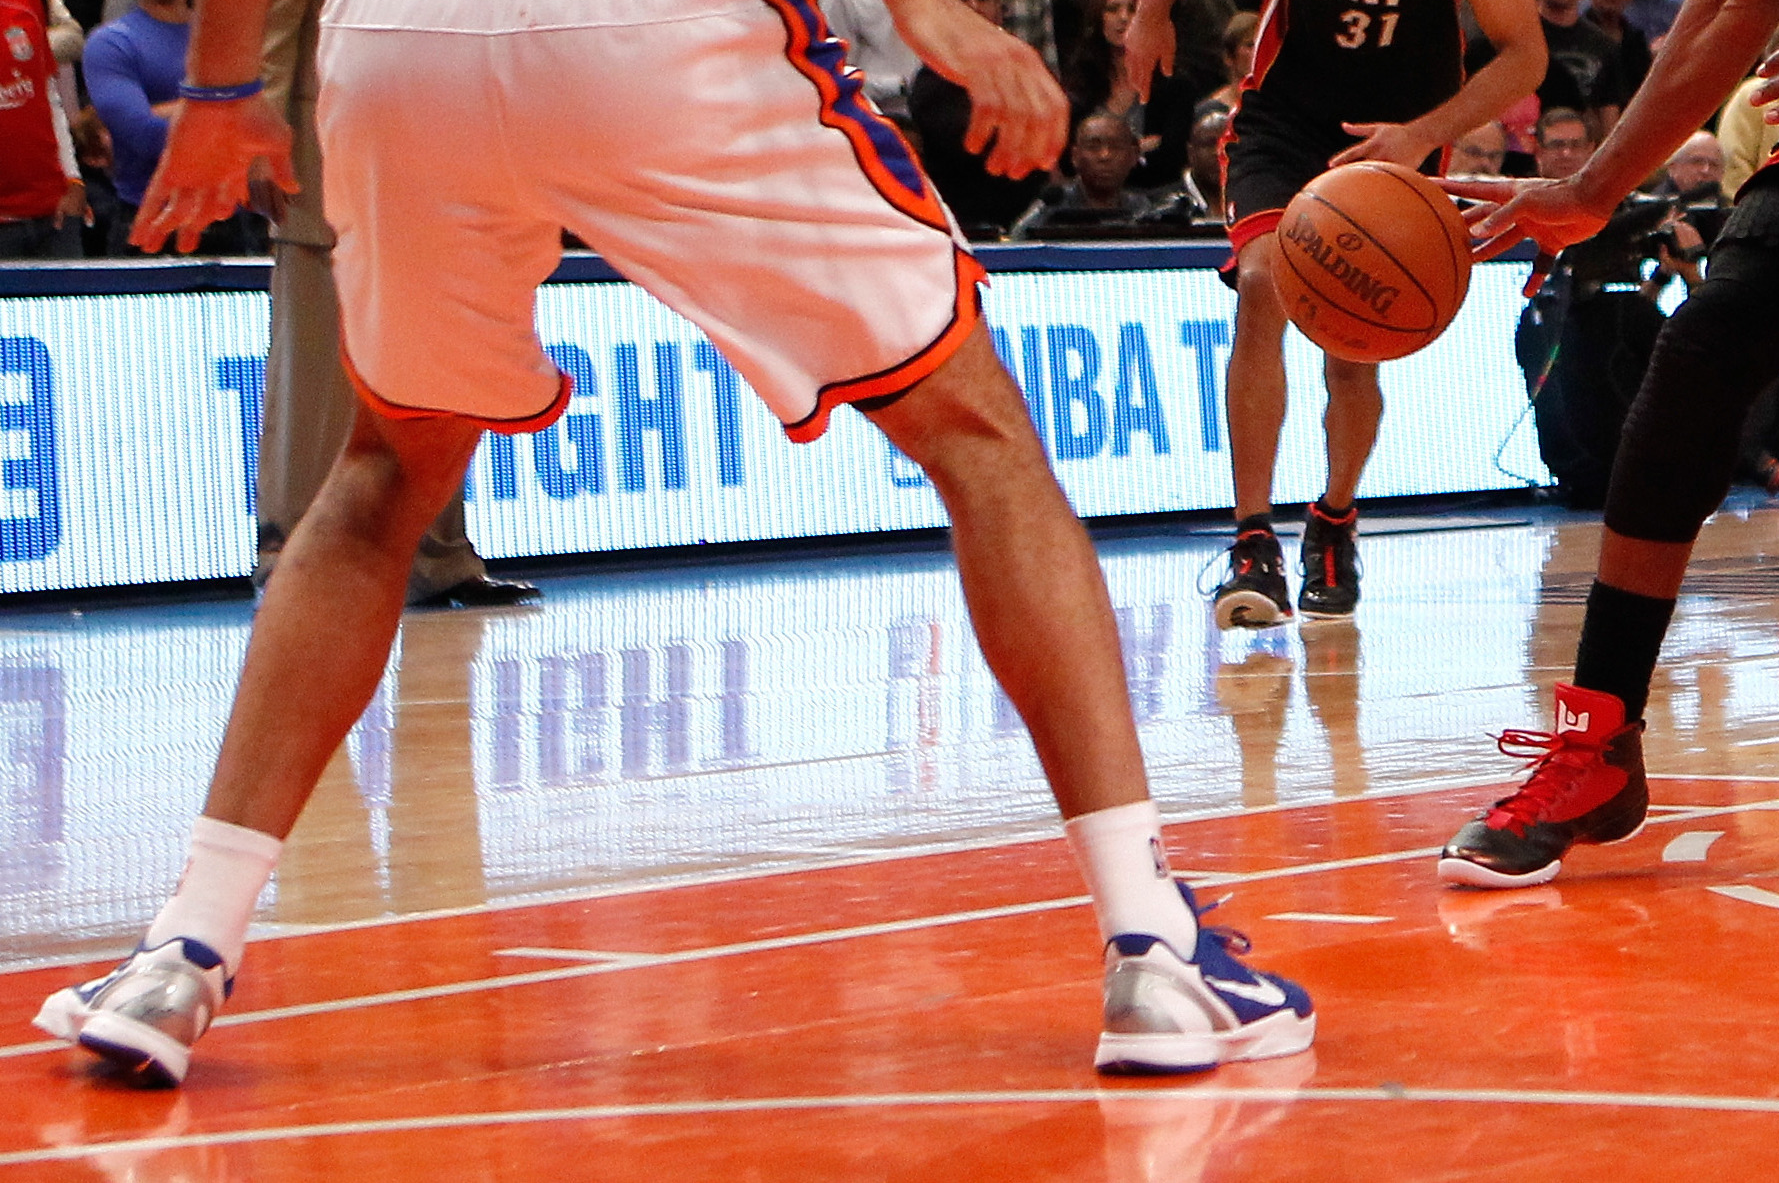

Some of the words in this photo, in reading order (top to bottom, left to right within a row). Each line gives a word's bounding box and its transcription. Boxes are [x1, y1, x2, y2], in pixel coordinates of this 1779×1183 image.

[1335, 9, 1400, 49] 31
[1286, 214, 1400, 319] SPALDING
[1179, 319, 1229, 453] T
